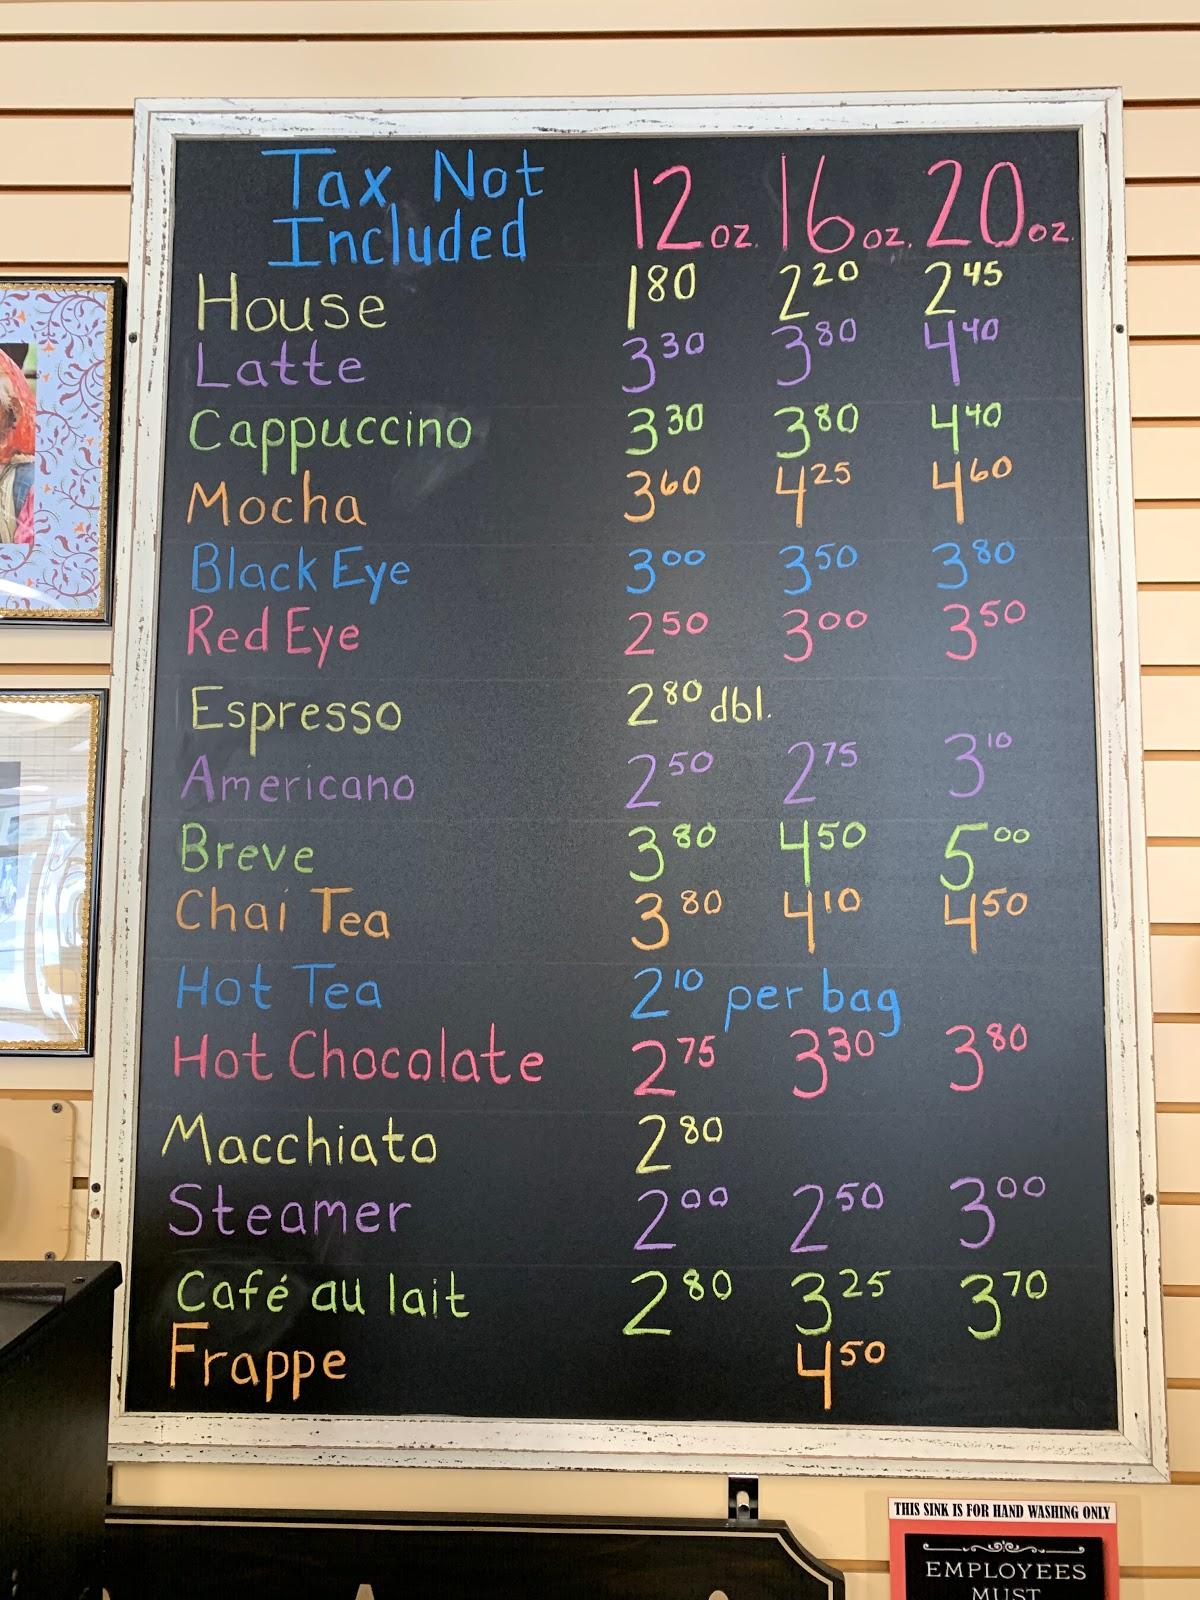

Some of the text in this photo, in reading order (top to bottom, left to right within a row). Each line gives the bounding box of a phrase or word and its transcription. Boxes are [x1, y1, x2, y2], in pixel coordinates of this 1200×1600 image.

[260, 147, 545, 210] Tax Not
[267, 196, 527, 268] Included
[197, 271, 387, 333] House
[196, 339, 365, 389] Latte
[189, 408, 472, 476] Cappuccino
[186, 469, 367, 526] Mocha
[191, 542, 411, 605] Black Eye
[187, 604, 360, 669] Red Eye
[191, 685, 402, 757] Espresso
[710, 685, 772, 724] dbl.
[180, 754, 415, 802] Americano
[181, 822, 314, 873] Breve
[176, 886, 390, 939] Chai Tea
[176, 963, 382, 1010] Hot Tea
[724, 985, 803, 1033] per
[822, 967, 901, 1038] bag
[174, 1022, 544, 1085] Hot Chocolate
[161, 1113, 437, 1167] Macchiato
[168, 1183, 412, 1236] Steamer
[176, 1268, 470, 1318] Café au lait
[169, 1321, 347, 1403] Frappe
[894, 1502, 1111, 1520] THIS SINK IS FOR HAND WASHING ONLY
[925, 1561, 1086, 1580] EMPLOYEES
[972, 1587, 1041, 1600] MUST
